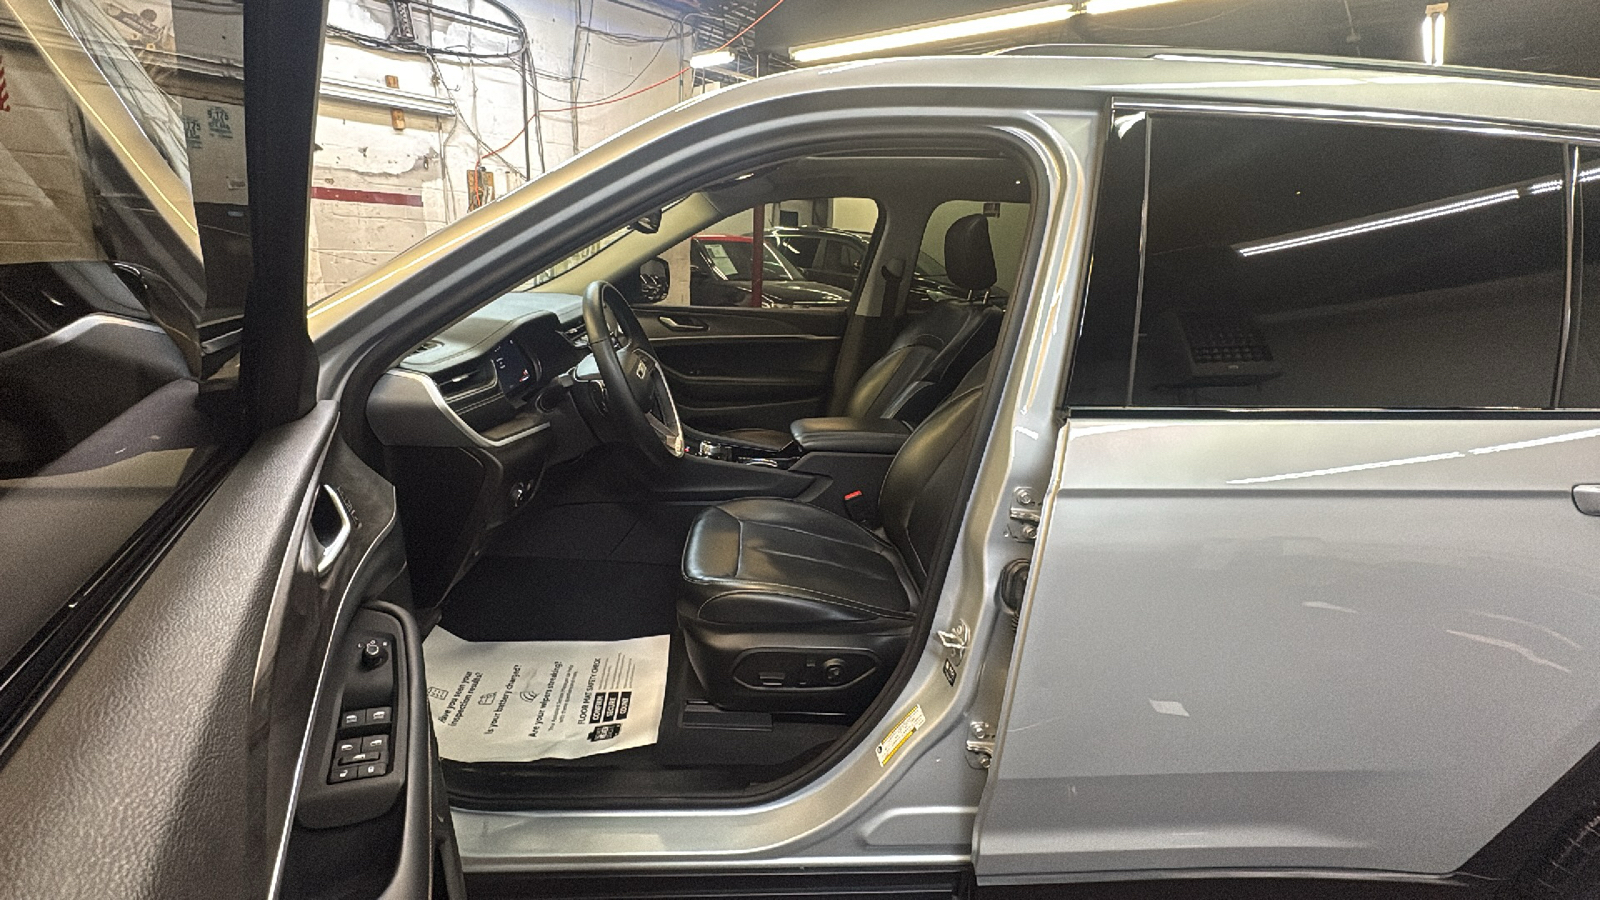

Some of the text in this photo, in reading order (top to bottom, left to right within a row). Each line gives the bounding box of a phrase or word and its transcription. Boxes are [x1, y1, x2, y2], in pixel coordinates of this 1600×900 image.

[493, 691, 513, 712] battery
[578, 658, 601, 724] FLOOR MAT SAFETY CHECK
[447, 698, 458, 710] you
[528, 726, 540, 737] Are
[535, 710, 545, 725] your
[540, 689, 552, 708] wipers
[592, 695, 603, 720] CONFIRM
[490, 713, 500, 727] your
